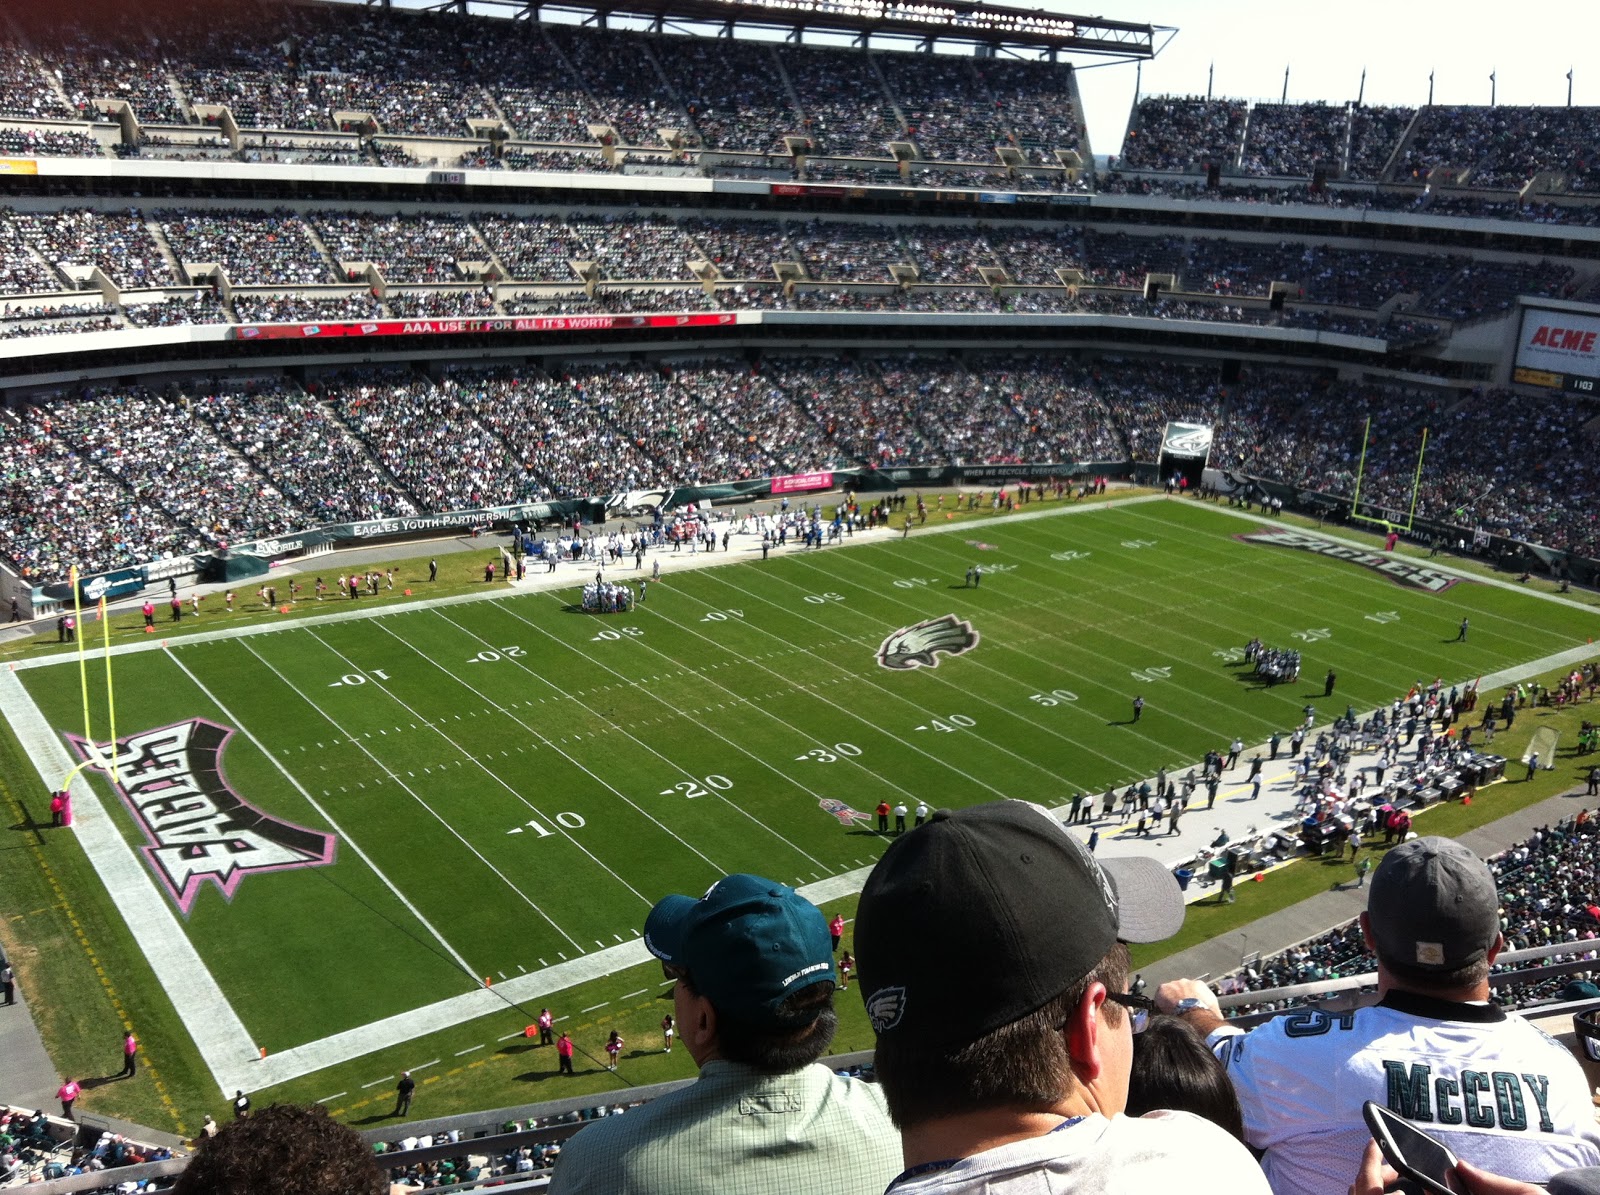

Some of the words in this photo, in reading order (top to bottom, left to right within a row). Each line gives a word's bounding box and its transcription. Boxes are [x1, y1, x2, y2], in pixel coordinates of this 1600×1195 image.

[439, 321, 466, 332] USE
[470, 320, 482, 331] IT
[486, 320, 512, 331] FOR
[515, 320, 540, 330] ALL
[542, 319, 565, 329] IT'S
[568, 318, 613, 329] WORTH
[1530, 326, 1598, 353] ACME
[963, 469, 984, 477] WHEN
[986, 468, 997, 476] WE
[353, 522, 399, 536] EAGLES
[402, 517, 440, 531] YOUTH
[443, 510, 517, 526] PARTNERSHIP
[1036, 689, 1079, 707] 50
[930, 714, 977, 733] 40
[808, 743, 863, 763] 30
[675, 774, 734, 799] 20
[519, 811, 587, 839] 10
[1383, 1060, 1554, 1133] McCOY
